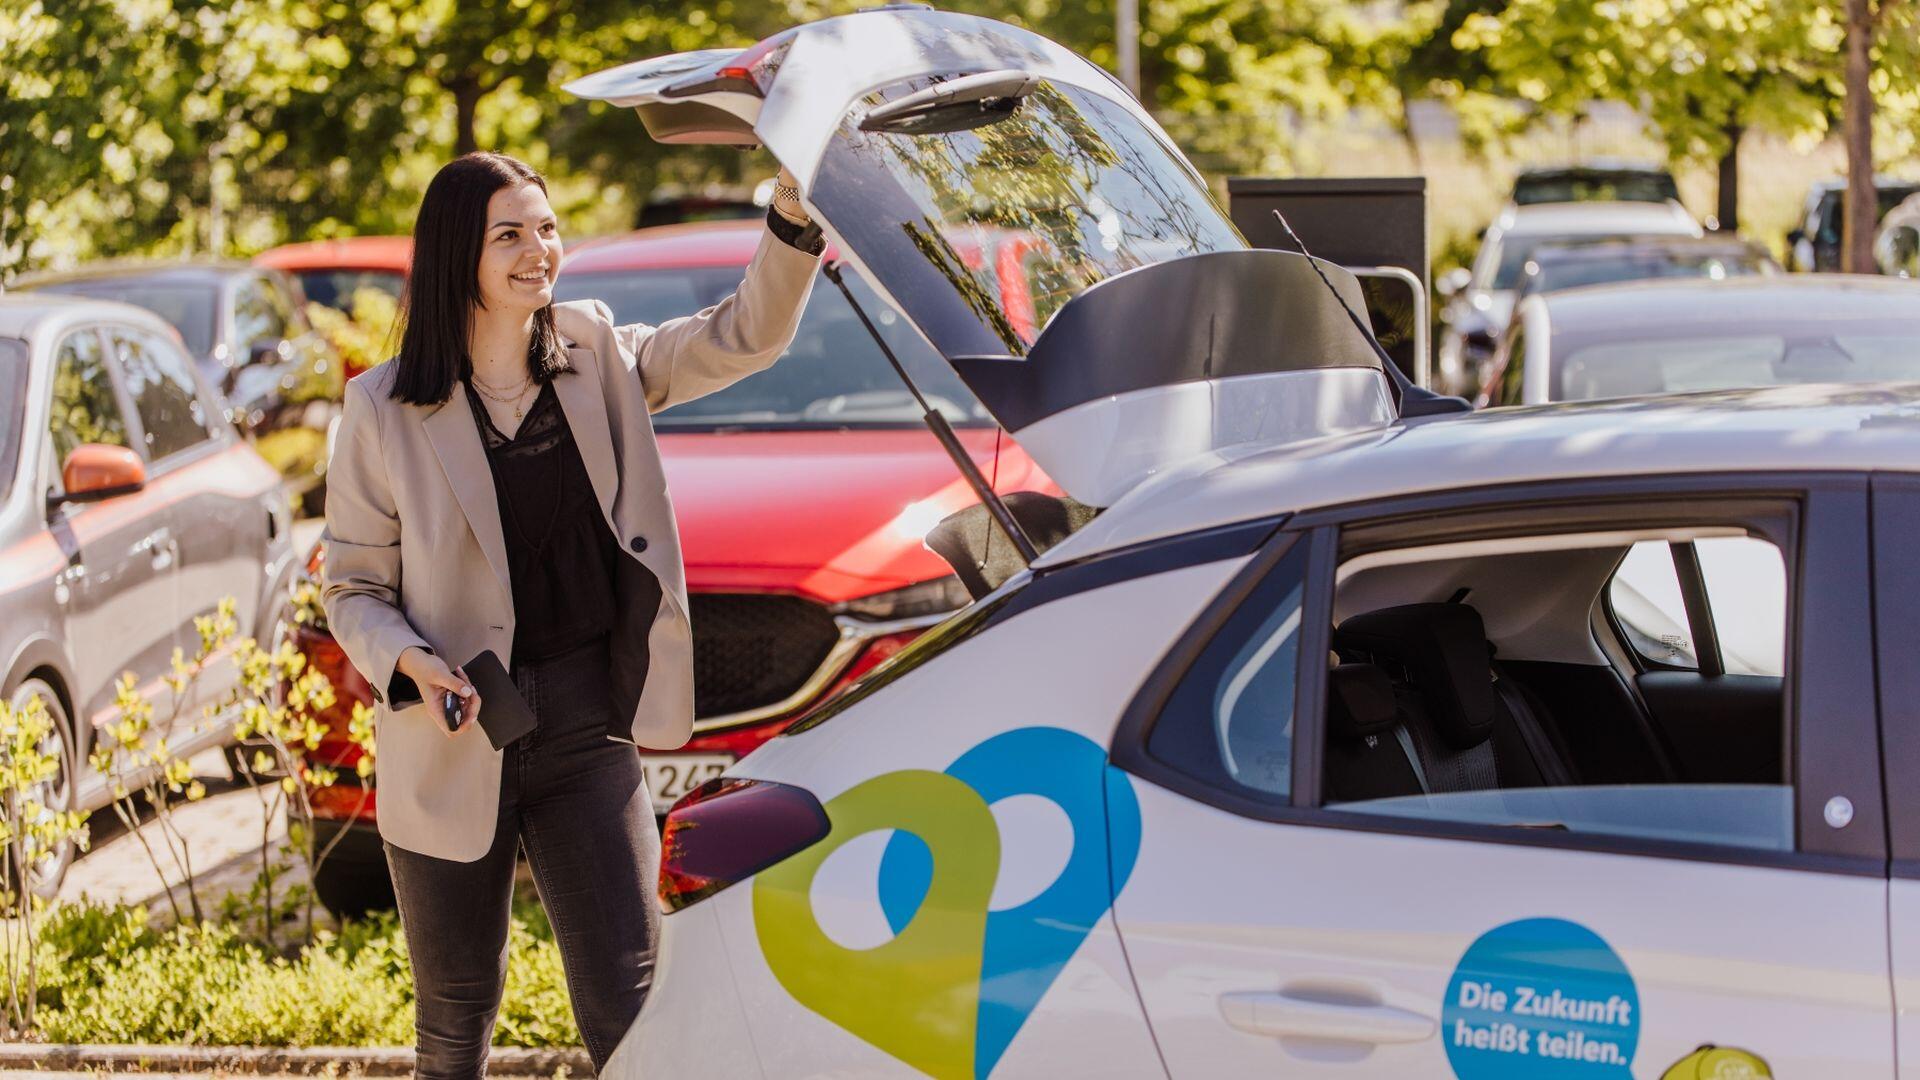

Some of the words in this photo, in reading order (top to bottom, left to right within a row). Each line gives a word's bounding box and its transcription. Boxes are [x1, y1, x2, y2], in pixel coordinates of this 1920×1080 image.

[1459, 981, 1508, 1012] Die
[1512, 986, 1632, 1027] Zukunft
[1454, 1018, 1531, 1055] heißt
[1536, 1030, 1628, 1066] teilen.
